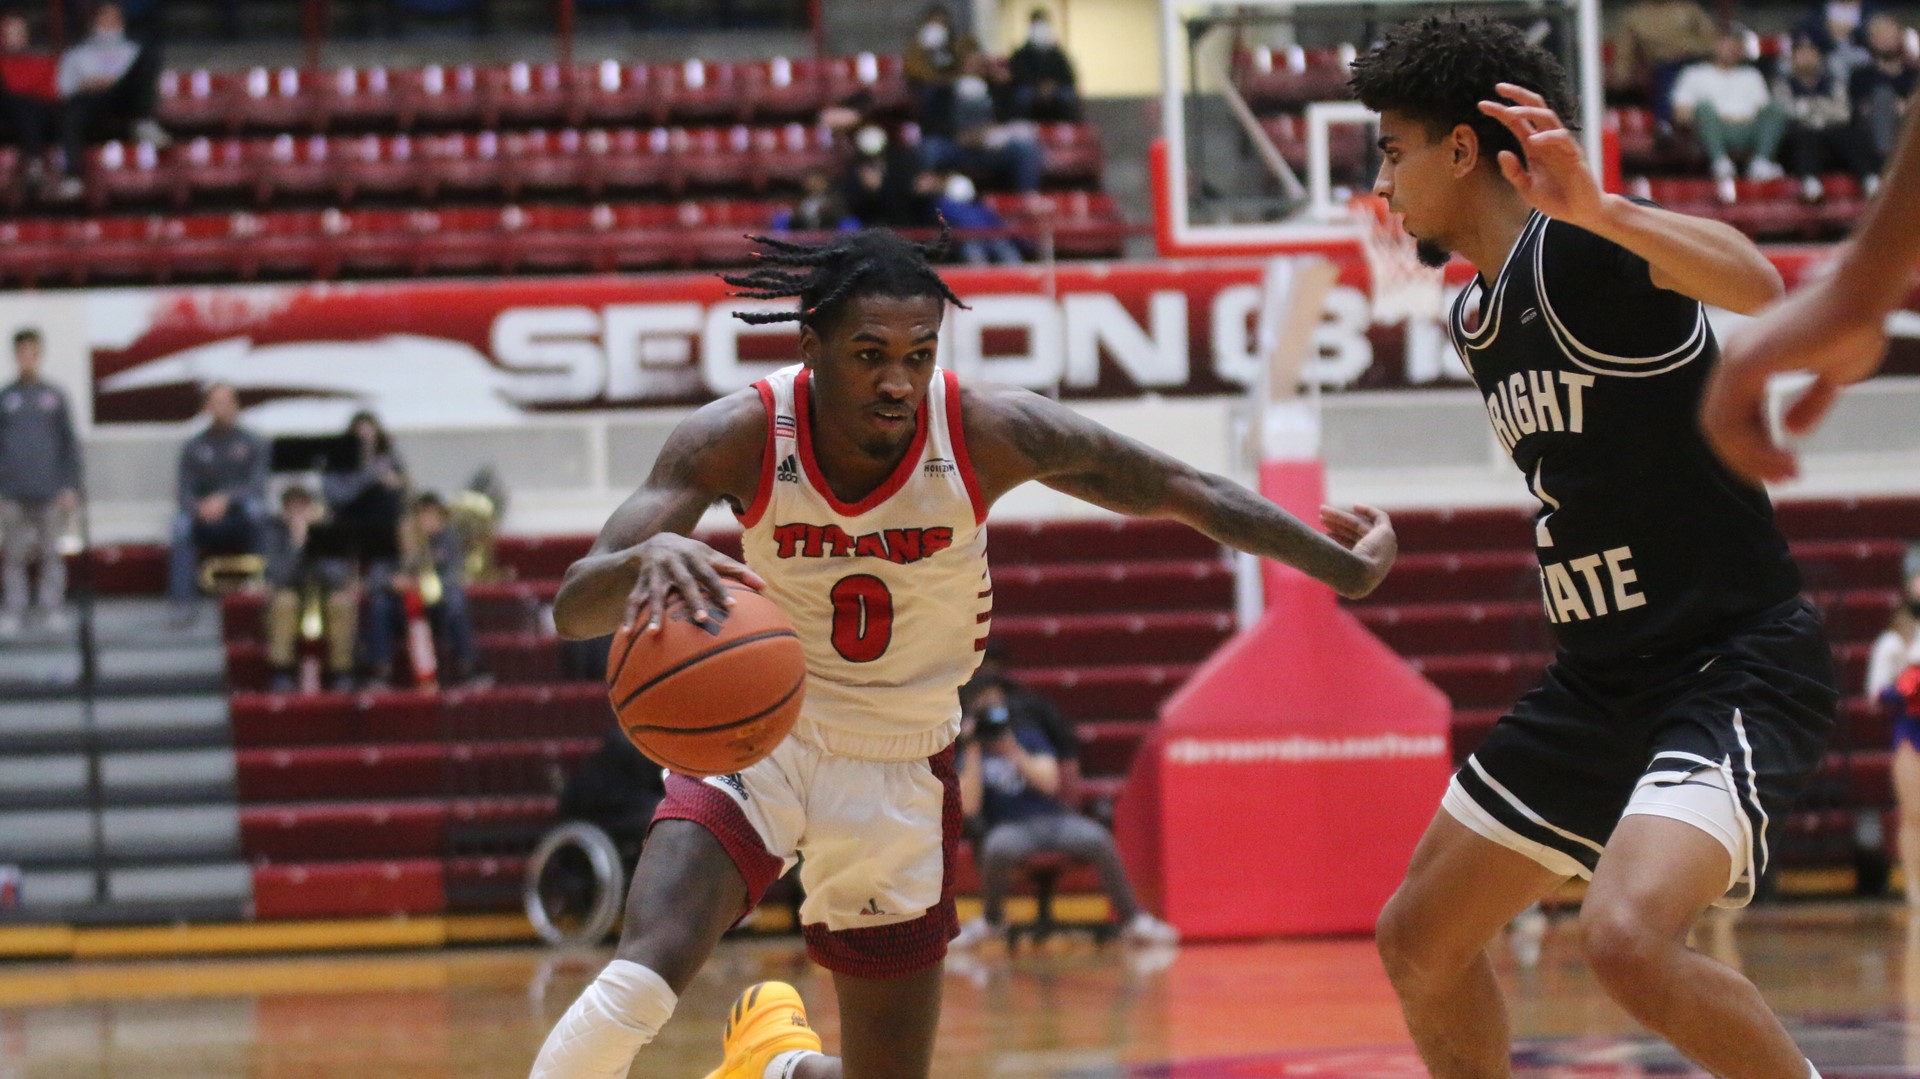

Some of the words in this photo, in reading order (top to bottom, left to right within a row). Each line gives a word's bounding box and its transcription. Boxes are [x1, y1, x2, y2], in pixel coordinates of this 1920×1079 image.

[1463, 345, 1596, 457] RIGHT
[773, 522, 954, 565] TITANS
[830, 573, 894, 663] 0
[1538, 545, 1647, 624] ATE
[716, 775, 749, 801] adidas
